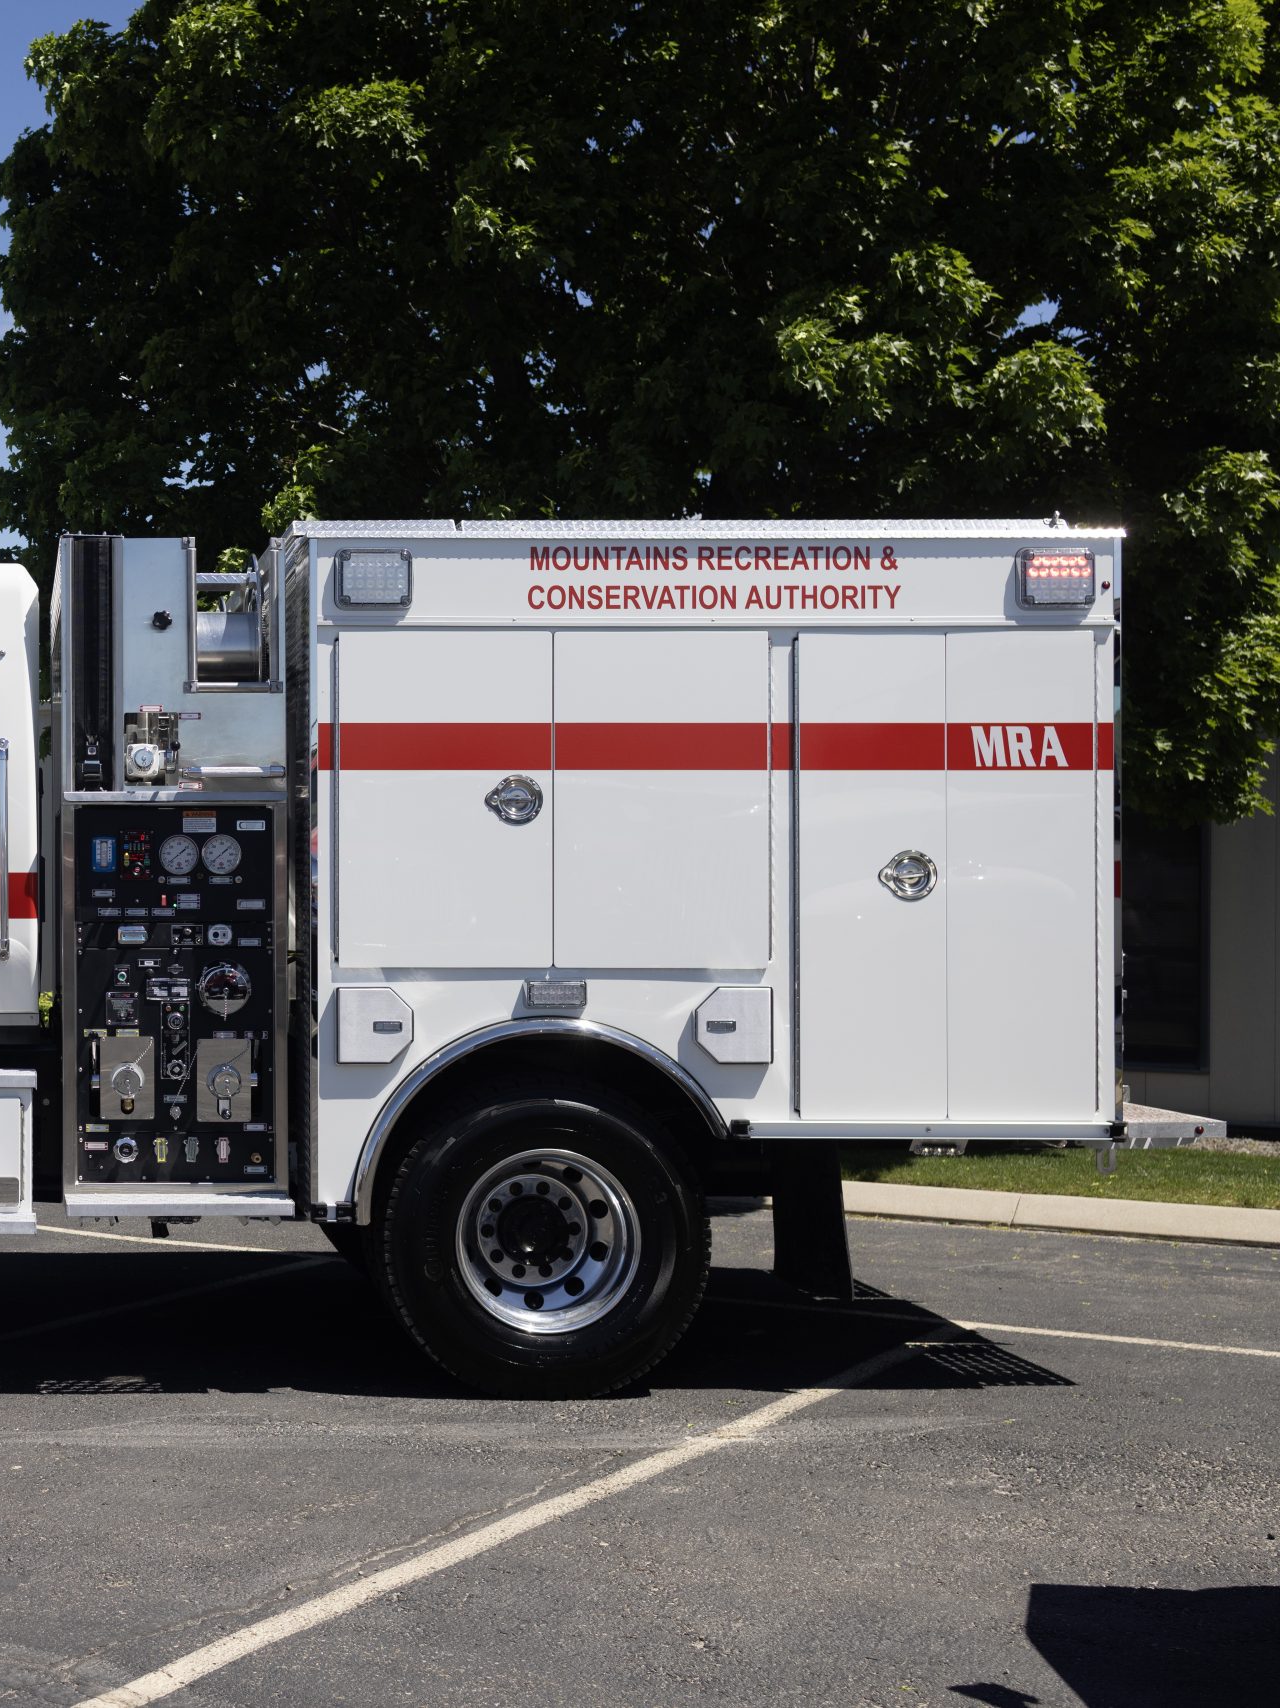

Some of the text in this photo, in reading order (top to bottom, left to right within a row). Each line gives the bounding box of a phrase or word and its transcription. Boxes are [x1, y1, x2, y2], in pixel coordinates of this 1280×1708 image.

[529, 546, 899, 571] MOUNTAINS RECREATION &
[527, 585, 902, 610] CONSERVATION AUTHORITY
[971, 725, 1069, 767] MRA
